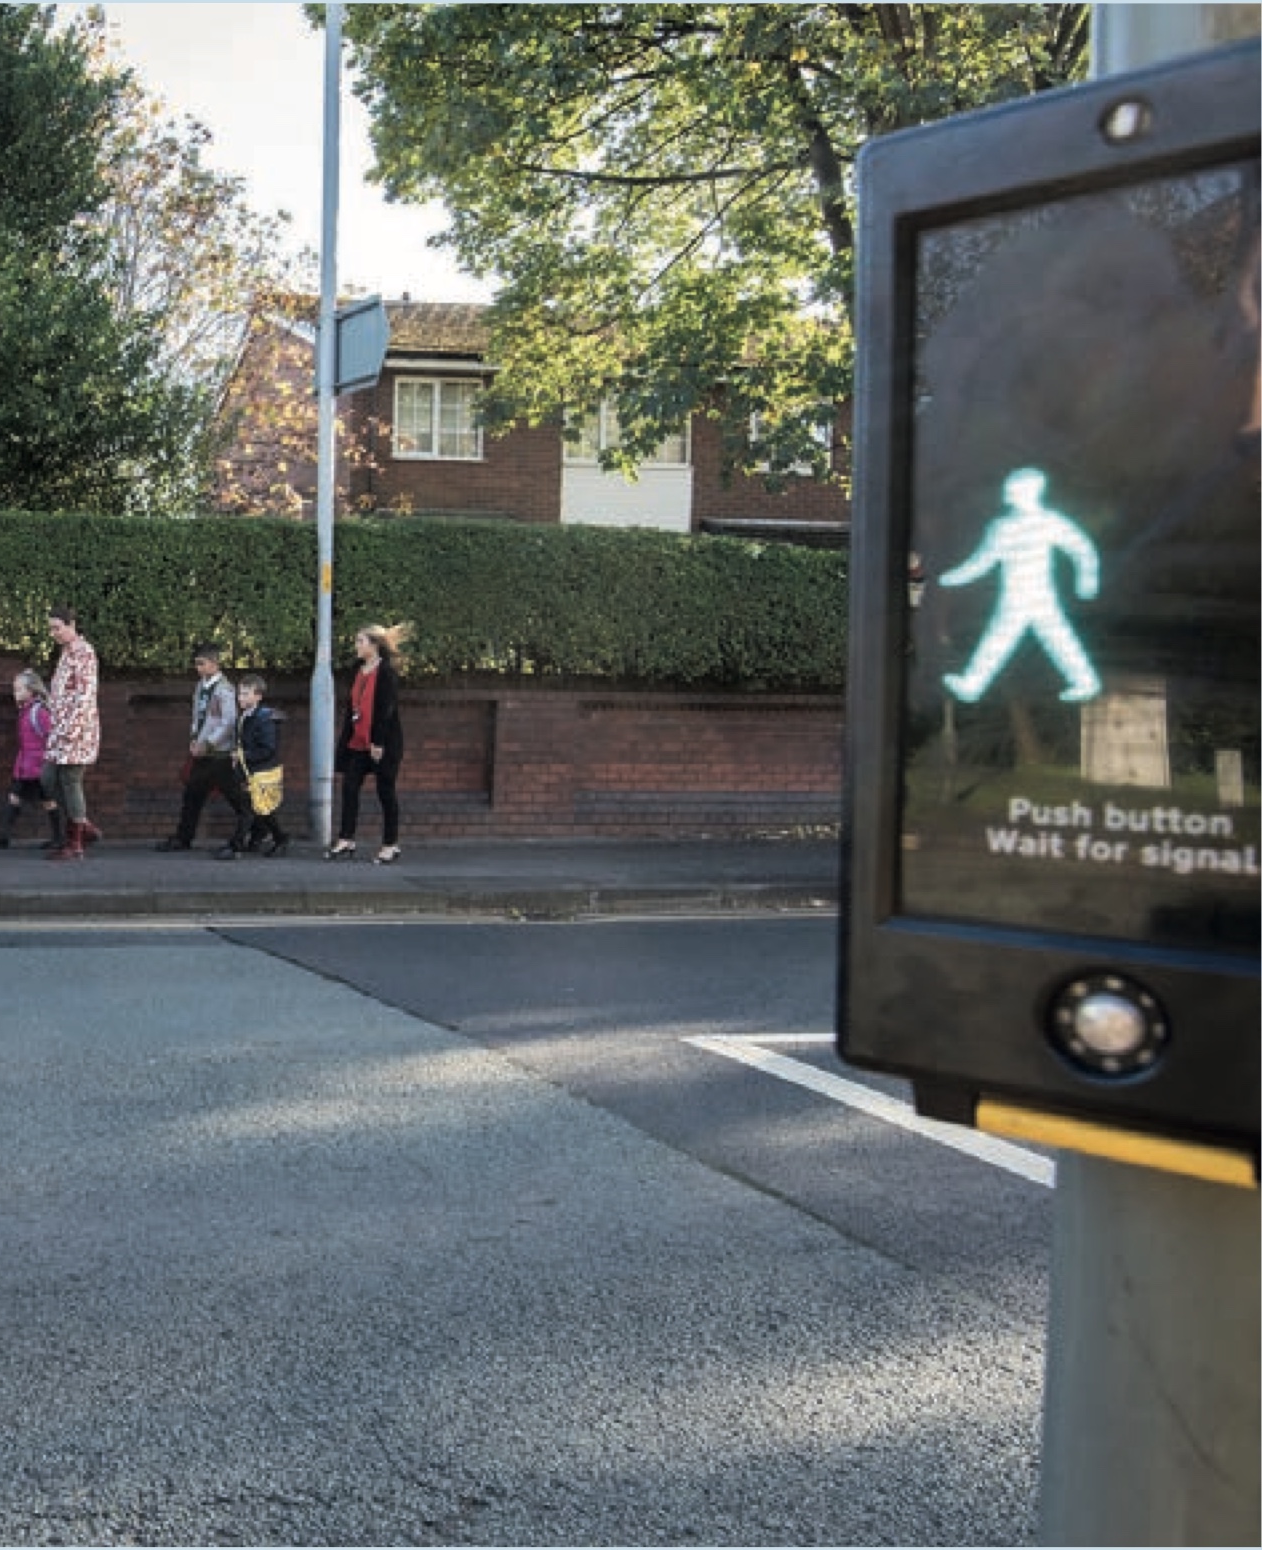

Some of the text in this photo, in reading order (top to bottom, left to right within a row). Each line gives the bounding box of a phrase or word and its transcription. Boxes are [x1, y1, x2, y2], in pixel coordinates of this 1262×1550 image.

[1008, 797, 1234, 837] Push button
[986, 826, 1260, 875] Wait for signal
